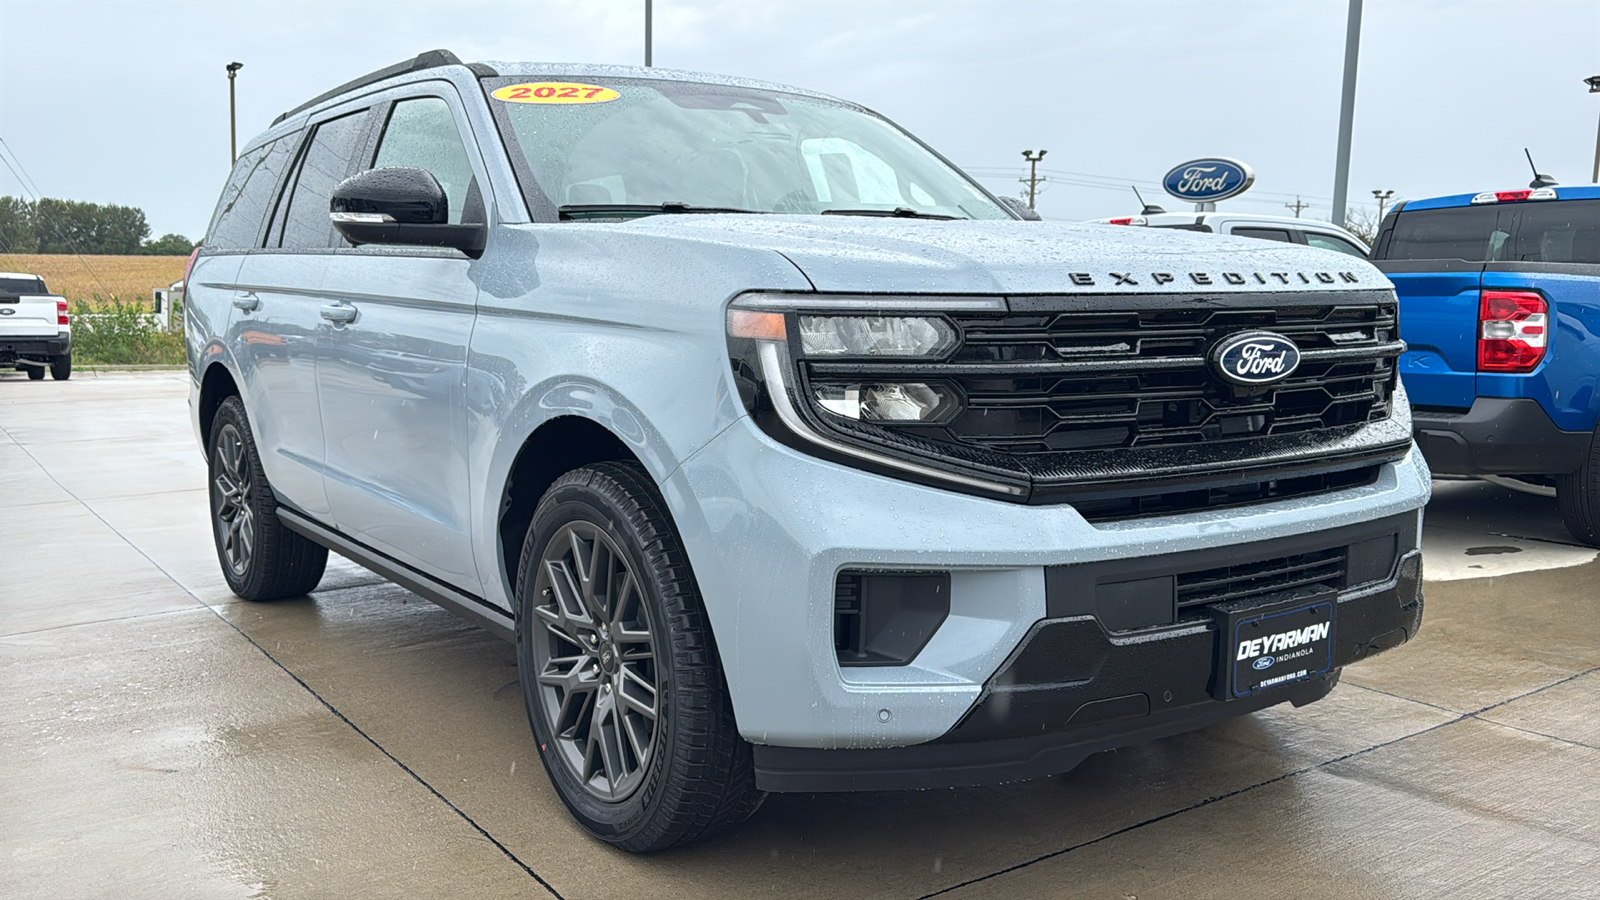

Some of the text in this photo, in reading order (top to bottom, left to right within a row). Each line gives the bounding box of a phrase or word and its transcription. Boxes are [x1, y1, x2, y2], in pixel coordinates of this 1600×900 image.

[508, 87, 604, 99] 2027
[1177, 166, 1229, 193] Ford
[1068, 271, 1359, 286] EXPEDITION
[1236, 344, 1286, 375] Ford
[1236, 621, 1331, 661] DEYARMAN
[1276, 647, 1314, 663] INDIANOLA
